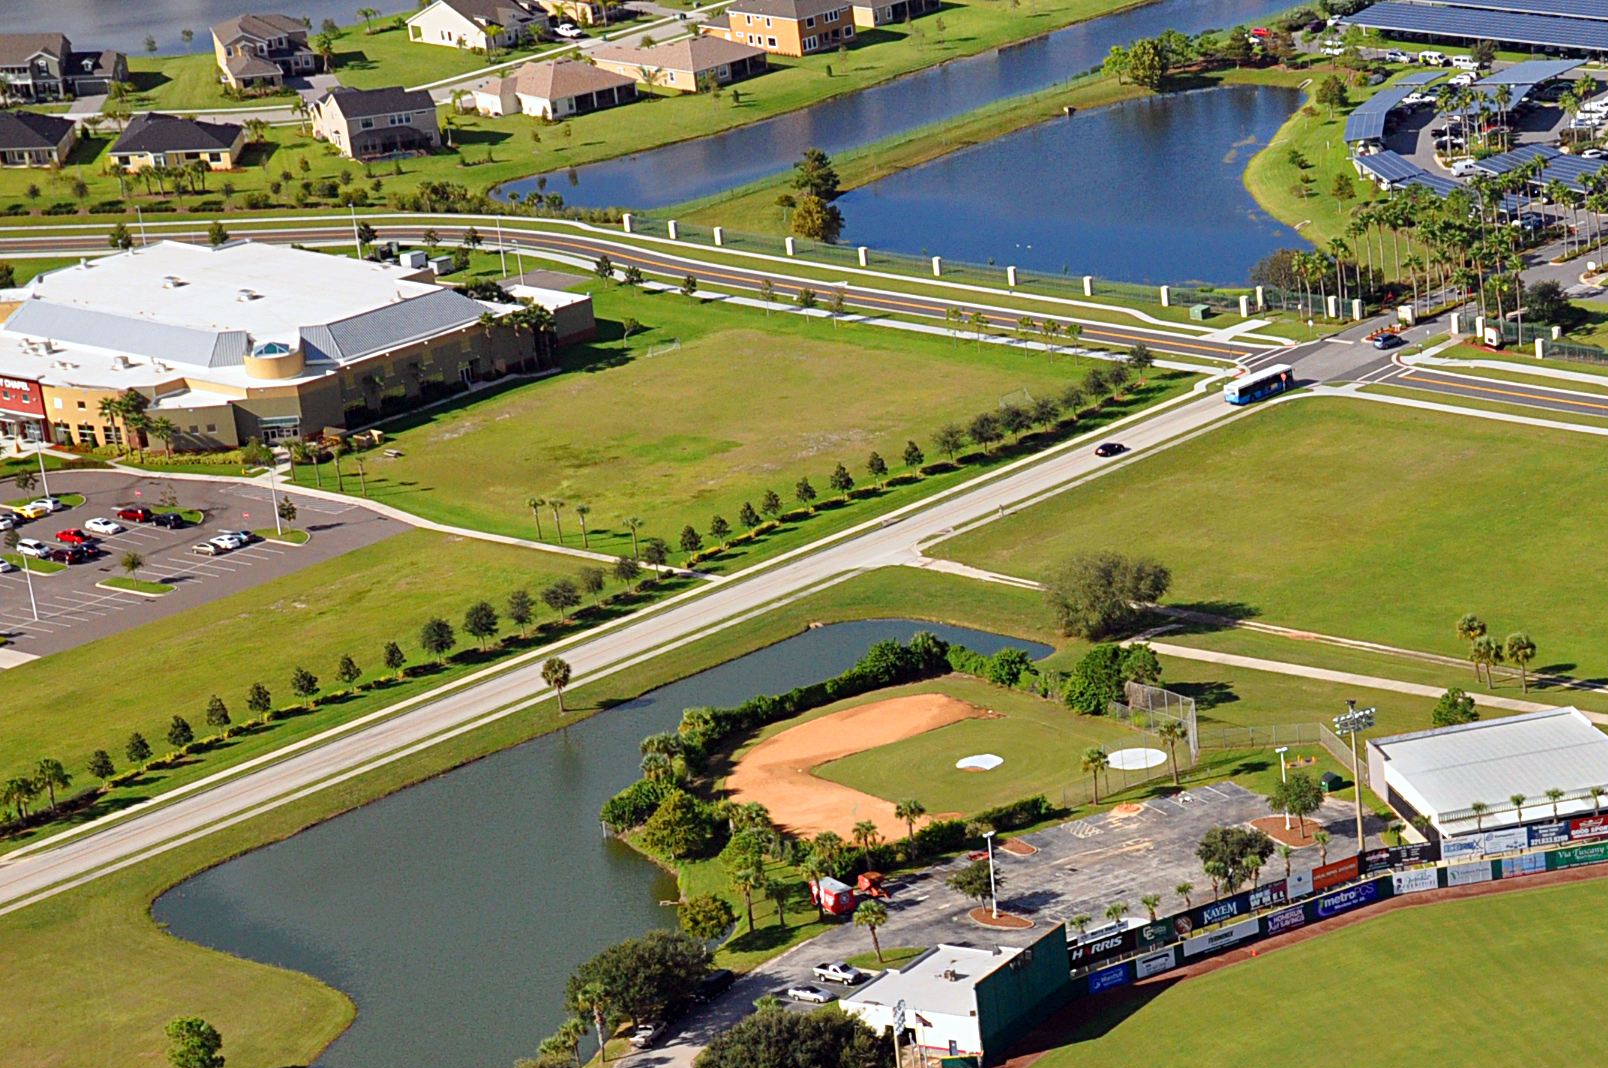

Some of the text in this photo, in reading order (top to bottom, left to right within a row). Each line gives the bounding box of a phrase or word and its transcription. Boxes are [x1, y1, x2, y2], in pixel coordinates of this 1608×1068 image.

[1571, 828, 1589, 836] GOOD
[1558, 846, 1605, 858] Via Tuscany
[1324, 882, 1374, 907] metroPCS
[1203, 902, 1238, 925] KAYEM
[1280, 914, 1305, 928] SAVINGS
[1208, 931, 1234, 944] TERMINIX
[1072, 936, 1123, 960] HARRIS
